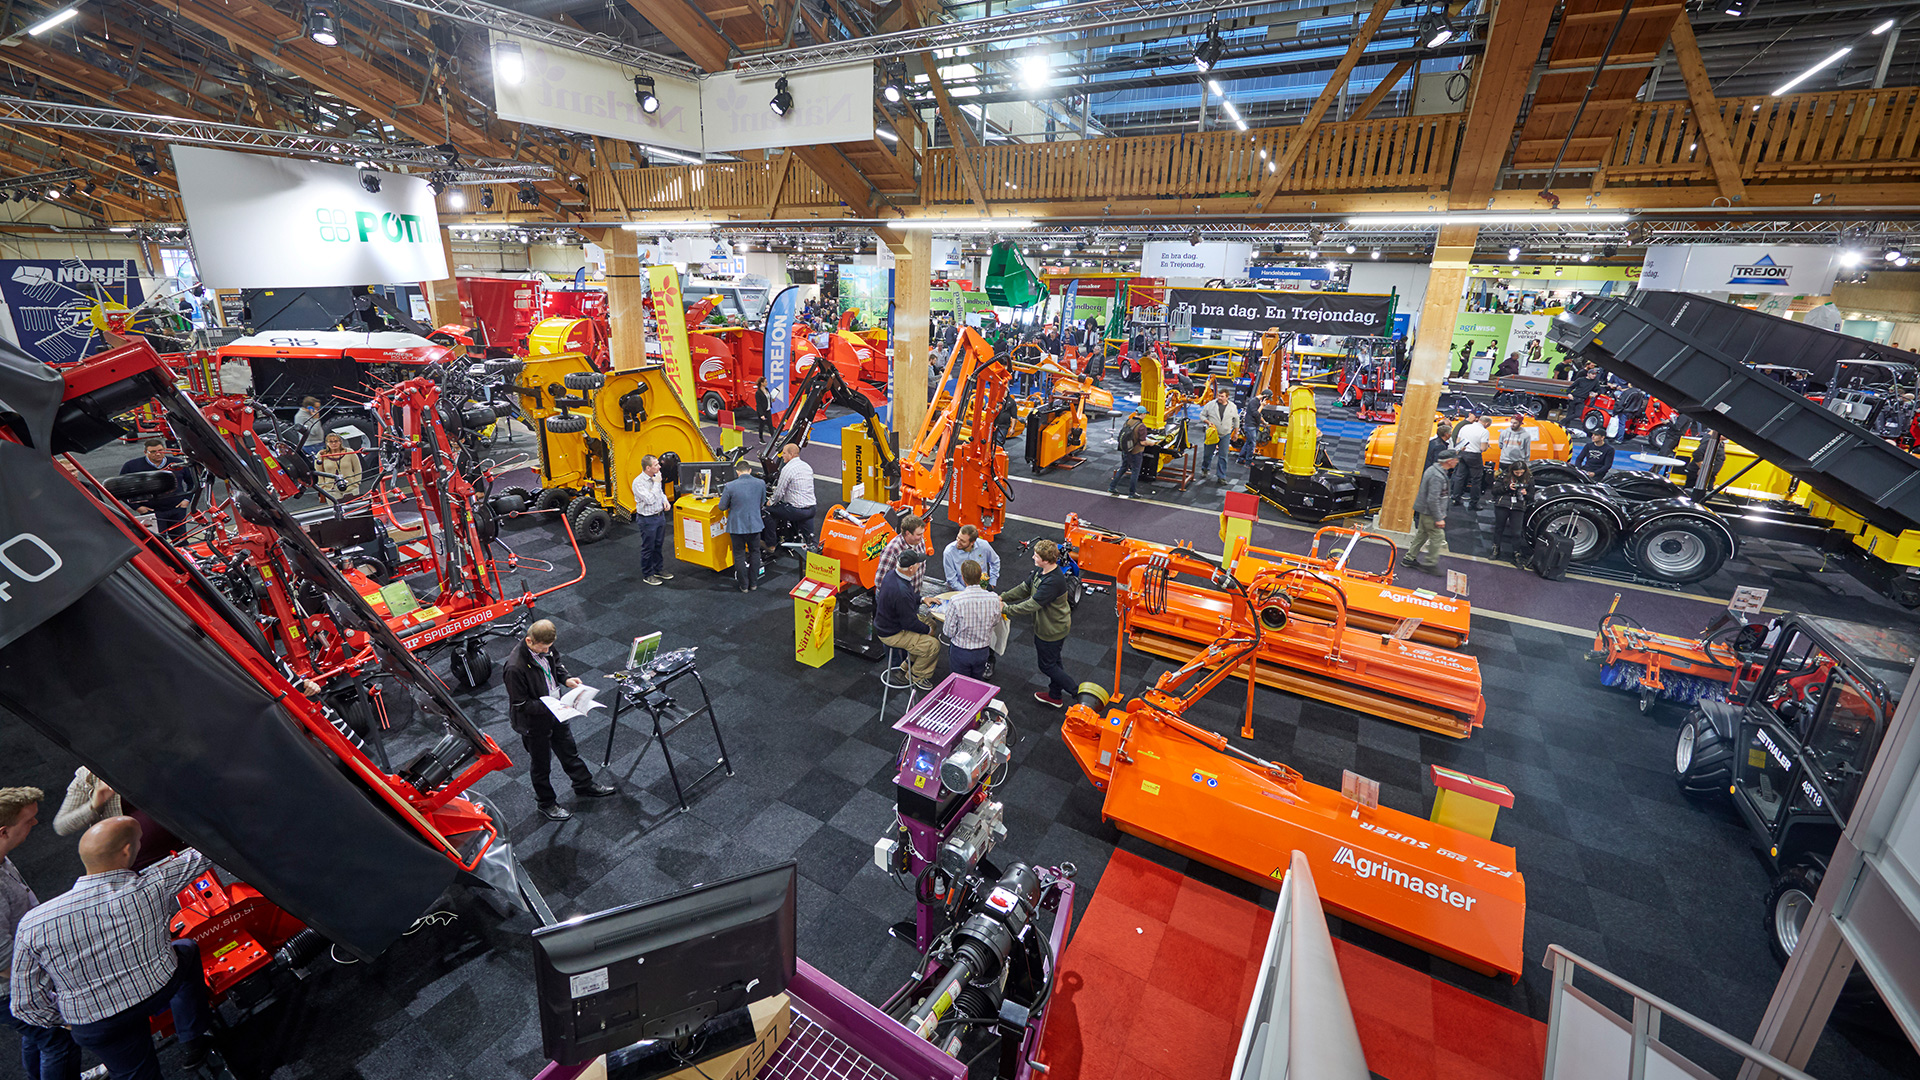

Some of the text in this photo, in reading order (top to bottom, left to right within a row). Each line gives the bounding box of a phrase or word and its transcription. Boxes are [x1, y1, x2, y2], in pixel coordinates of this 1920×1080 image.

[1170, 252, 1181, 260] bra
[1182, 253, 1198, 262] dag.
[1170, 261, 1206, 270] Trejondag.
[57, 267, 126, 286] NORJE
[1260, 269, 1302, 277] Handelsbanken
[1736, 266, 1787, 278] TREJON
[67, 312, 94, 327] 75
[1178, 302, 1380, 326] En bra dag. En Trejondag.
[1459, 323, 1497, 333] agriwise
[770, 314, 788, 384] TREJON
[951, 466, 959, 505] Agrimaster
[828, 529, 858, 543] Agrimaster
[808, 562, 834, 575] Närlant
[1380, 589, 1460, 613] Agrimaster
[424, 620, 463, 642] SPIDER
[1400, 651, 1473, 672] Agrimaster
[1763, 735, 1792, 772] THALER
[1801, 780, 1824, 807] 48T18
[1359, 821, 1431, 850] SUPER
[1333, 846, 1477, 912] Agrimaster
[1473, 859, 1515, 879] FZL
[731, 1023, 778, 1080] LEH
